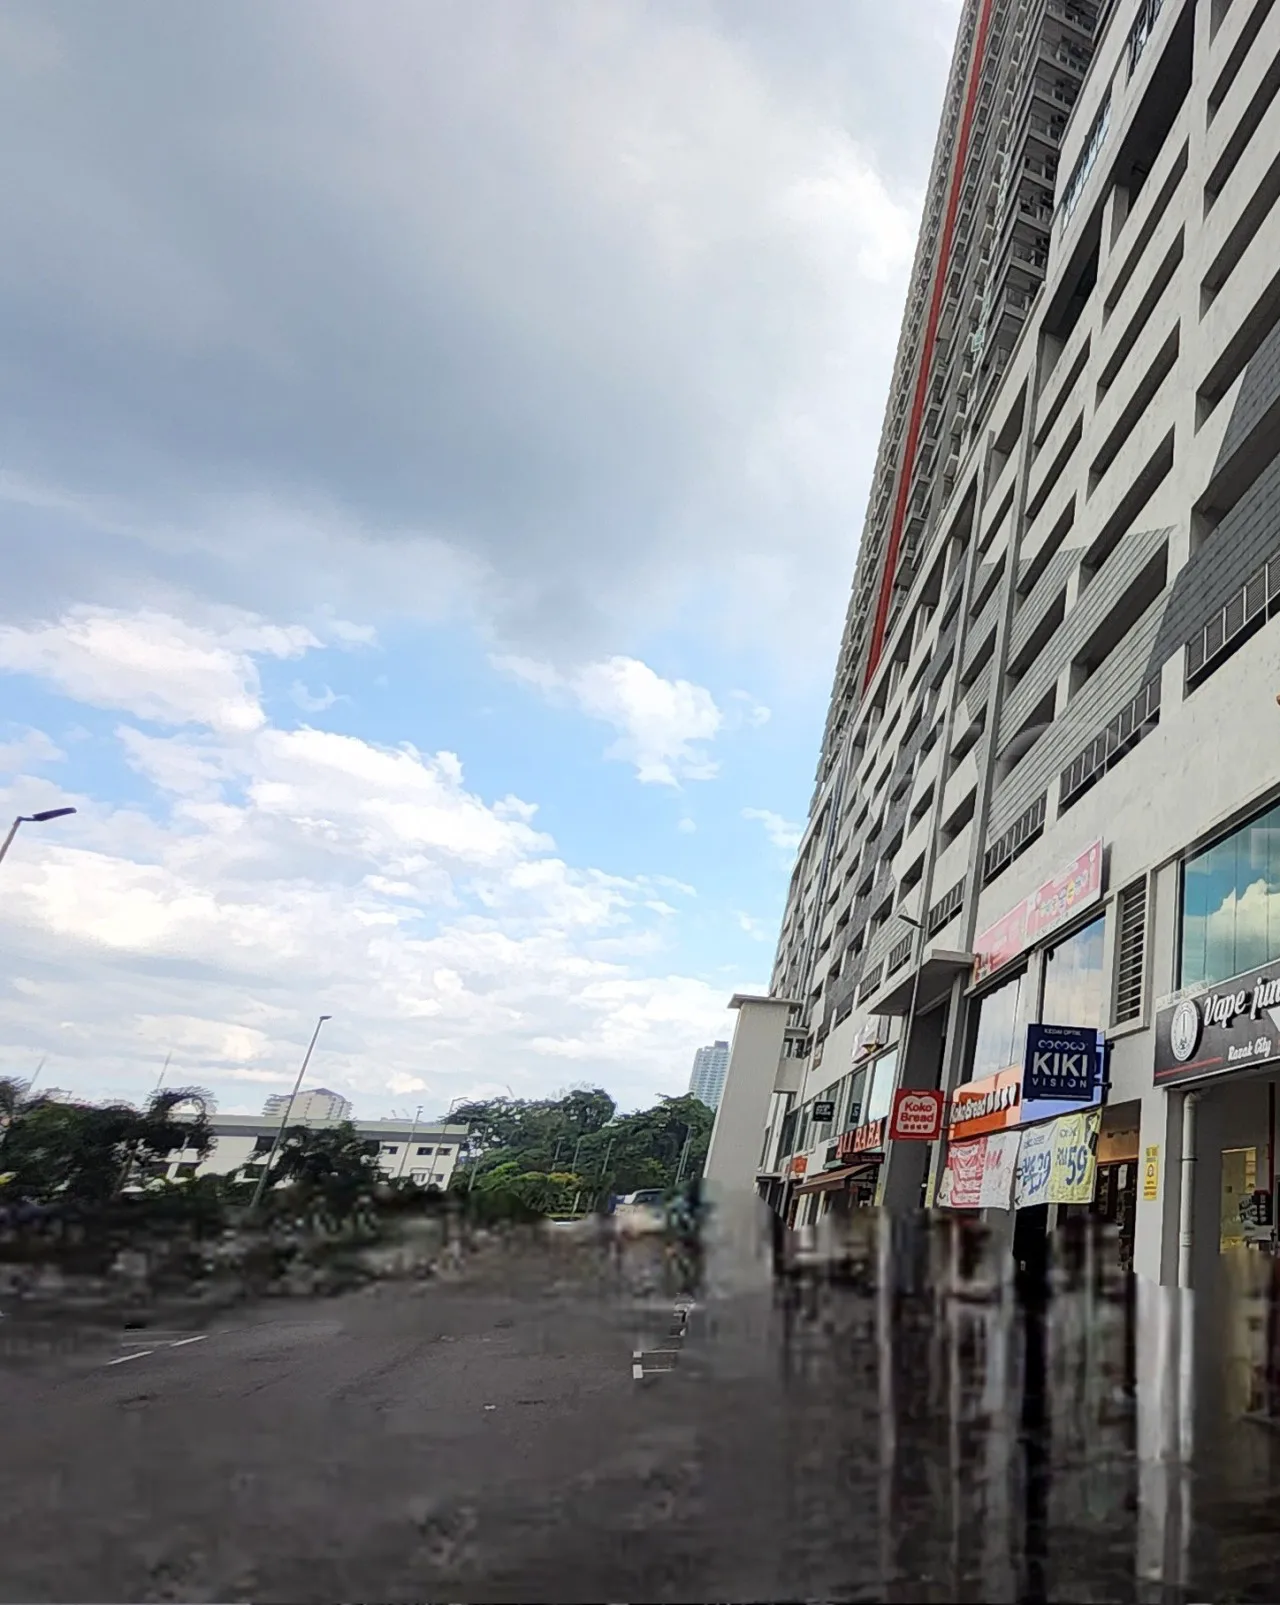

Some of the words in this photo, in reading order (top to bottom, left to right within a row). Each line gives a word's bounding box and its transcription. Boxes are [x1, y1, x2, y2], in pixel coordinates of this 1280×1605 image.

[1203, 991, 1247, 1029] Vape
[1043, 1028, 1063, 1036] KEDAI
[1228, 1042, 1253, 1061] Razak
[1253, 1037, 1272, 1057] City
[1032, 1051, 1088, 1077] KIKI
[1032, 1077, 1088, 1089] VISION
[905, 1101, 933, 1112] Koko
[901, 1112, 935, 1123] Bread
